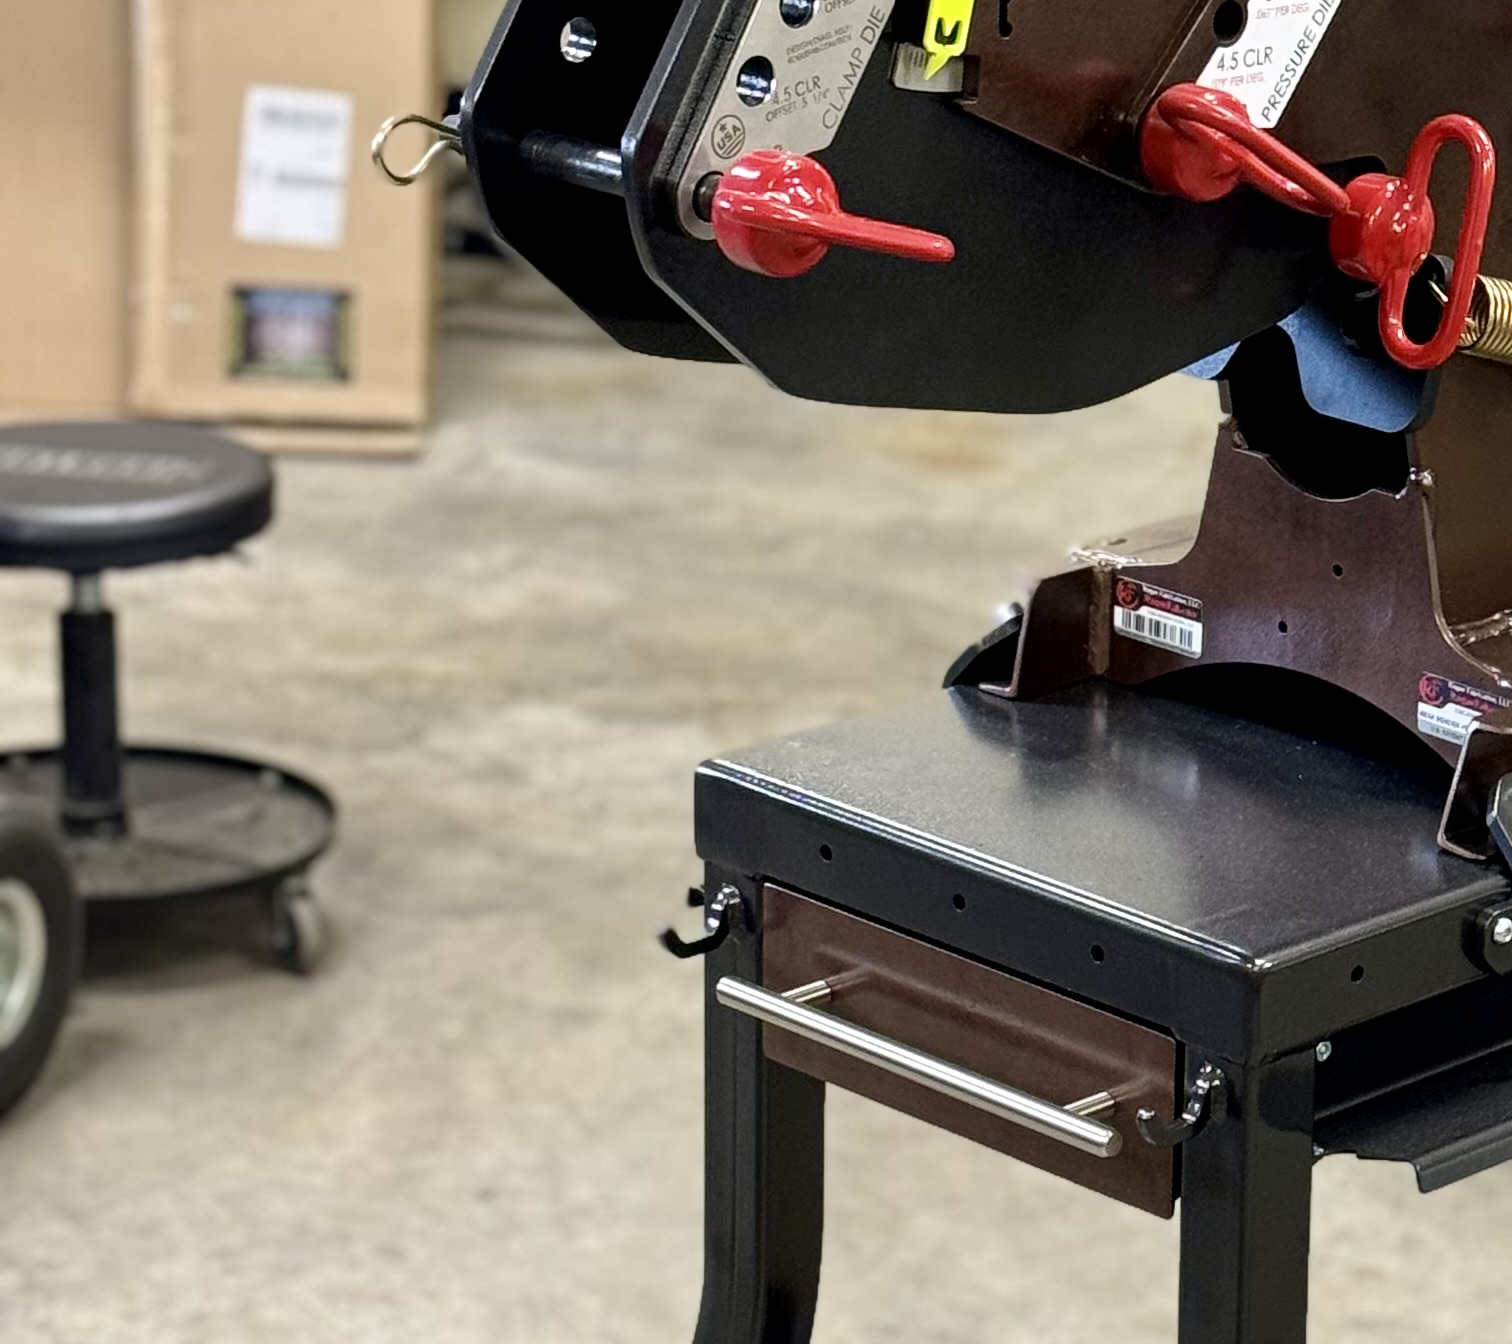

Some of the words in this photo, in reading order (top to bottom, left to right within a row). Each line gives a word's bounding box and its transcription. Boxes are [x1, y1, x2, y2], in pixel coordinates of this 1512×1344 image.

[822, 47, 864, 130] CLAMP
[860, 5, 886, 46] DIE
[1217, 51, 1239, 71] 4.5
[1243, 46, 1273, 67] CLR
[1261, 25, 1317, 123] PRESSURE
[772, 86, 792, 106] 4.5
[794, 76, 821, 97] CLR
[765, 100, 797, 122] OFFSET
[717, 124, 742, 151] USA
